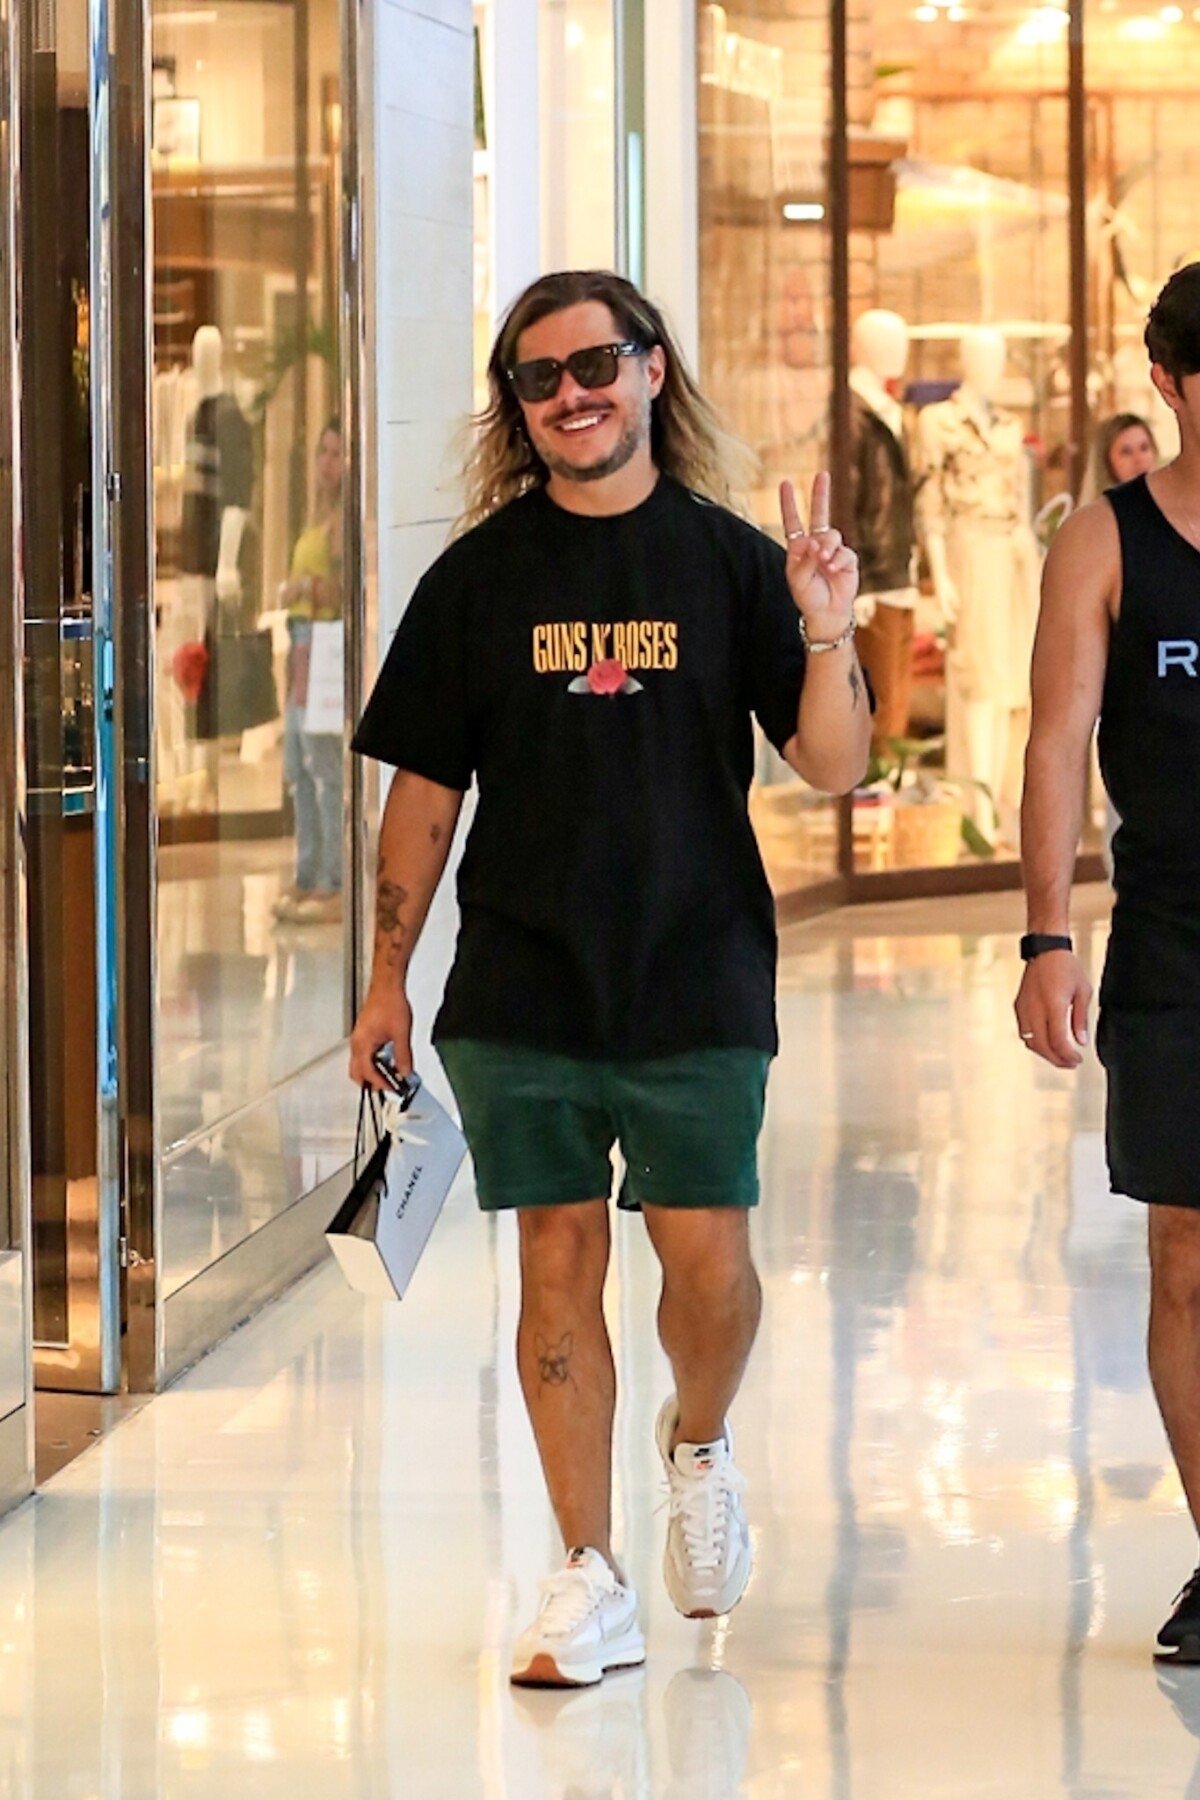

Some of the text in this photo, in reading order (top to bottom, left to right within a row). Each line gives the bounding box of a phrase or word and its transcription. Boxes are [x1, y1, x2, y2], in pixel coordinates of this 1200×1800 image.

[533, 621, 587, 673] GUNS
[614, 621, 678, 670] ROSES
[395, 1165, 423, 1220] CHANEL
